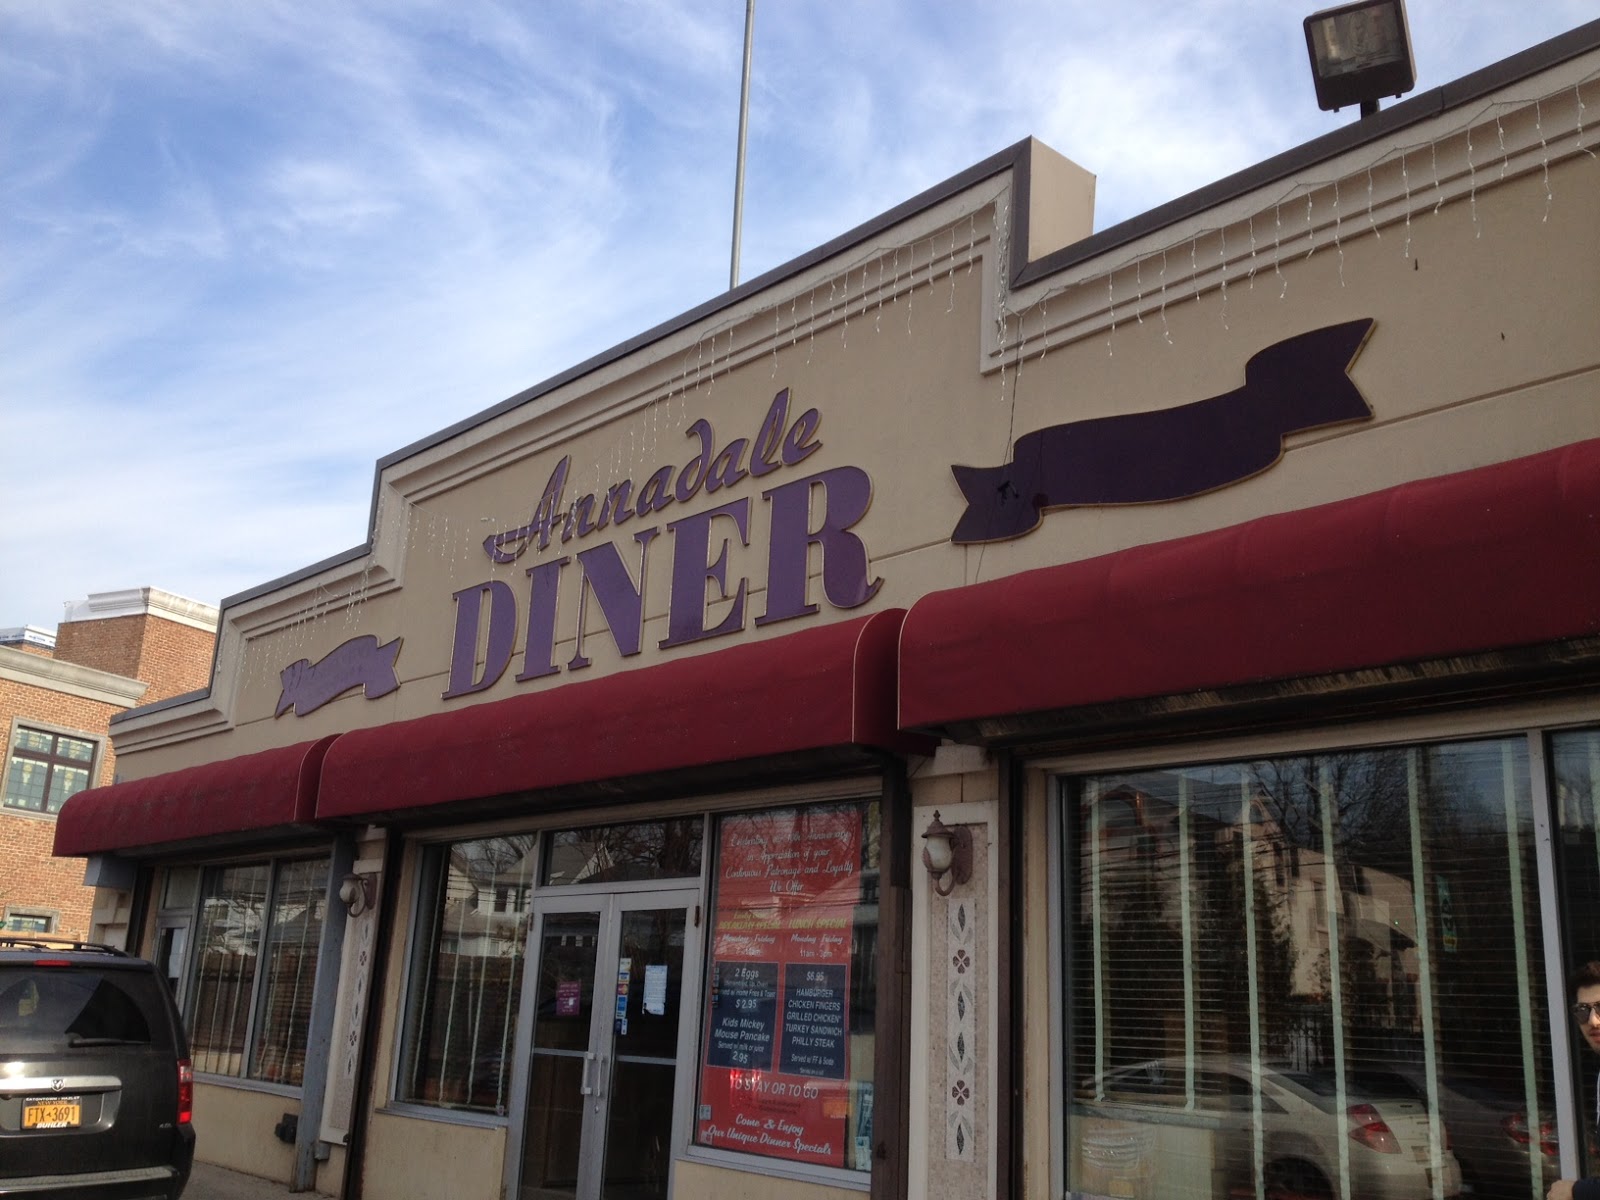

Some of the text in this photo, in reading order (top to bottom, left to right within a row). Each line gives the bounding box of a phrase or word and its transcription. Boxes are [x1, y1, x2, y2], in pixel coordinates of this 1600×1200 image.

[483, 387, 822, 563] Annadale
[441, 465, 885, 700] DINER
[726, 867, 762, 879] Continuous
[764, 865, 801, 881] Patronage
[804, 864, 820, 875] and
[770, 880, 804, 895] We Offer
[788, 917, 848, 929] LUNCH SPECIAL
[722, 933, 750, 944] Monday
[754, 933, 776, 943] Friday
[790, 933, 817, 944] Monday
[821, 933, 844, 945] Friday
[734, 968, 760, 980] 2 Eggs
[806, 971, 825, 981] $6.95
[796, 988, 834, 998] HAMBURGER
[788, 999, 841, 1011] CHICKEN FINGERS
[786, 1011, 813, 1021] GRILLED
[722, 1017, 765, 1031] Kids Mickey
[785, 1023, 843, 1037] TURKEY SANDWICH
[714, 1029, 770, 1042] Mouse Pancake
[718, 1041, 733, 1049] Served
[791, 1036, 835, 1048] PHILLY STEAK
[791, 1053, 807, 1063] Served
[730, 1077, 819, 1099] TO STAY OR TO GO
[28, 1106, 75, 1122] FTX 3691
[736, 1113, 804, 1136] Come & Enjoy
[708, 1125, 832, 1155] Our Unique Dinner Specials
